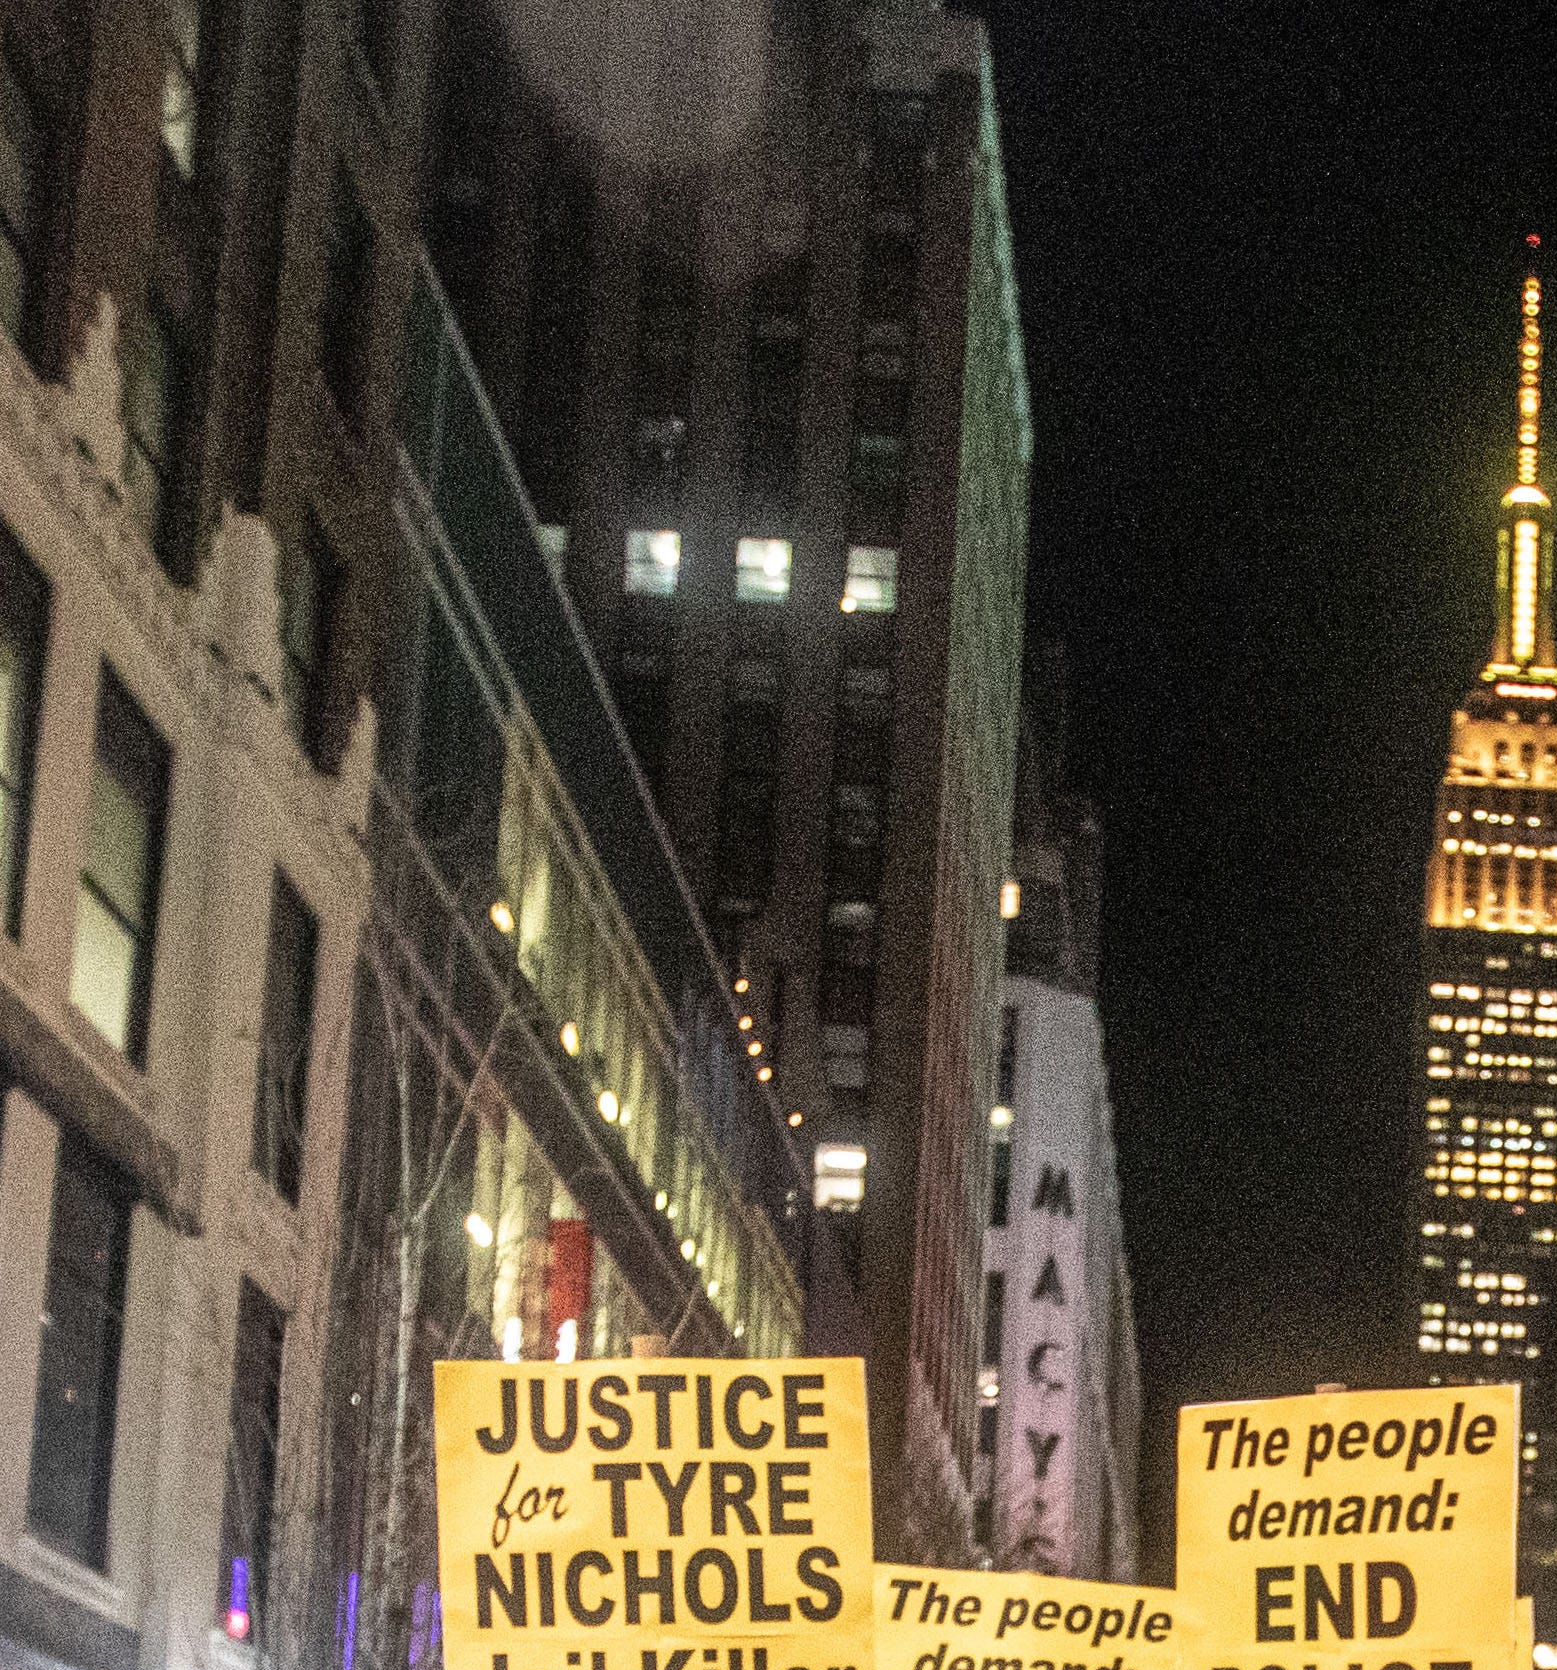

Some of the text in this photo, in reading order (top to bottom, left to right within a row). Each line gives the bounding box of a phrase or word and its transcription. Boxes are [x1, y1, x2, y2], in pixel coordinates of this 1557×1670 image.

[475, 1374, 828, 1453] JUSTICE
[1203, 1401, 1497, 1477] The people
[490, 1460, 814, 1549] for TYRE
[1229, 1479, 1459, 1541] demand:
[474, 1546, 843, 1629] NICHOLS
[889, 1579, 1173, 1647] The people
[1254, 1560, 1418, 1643] END
